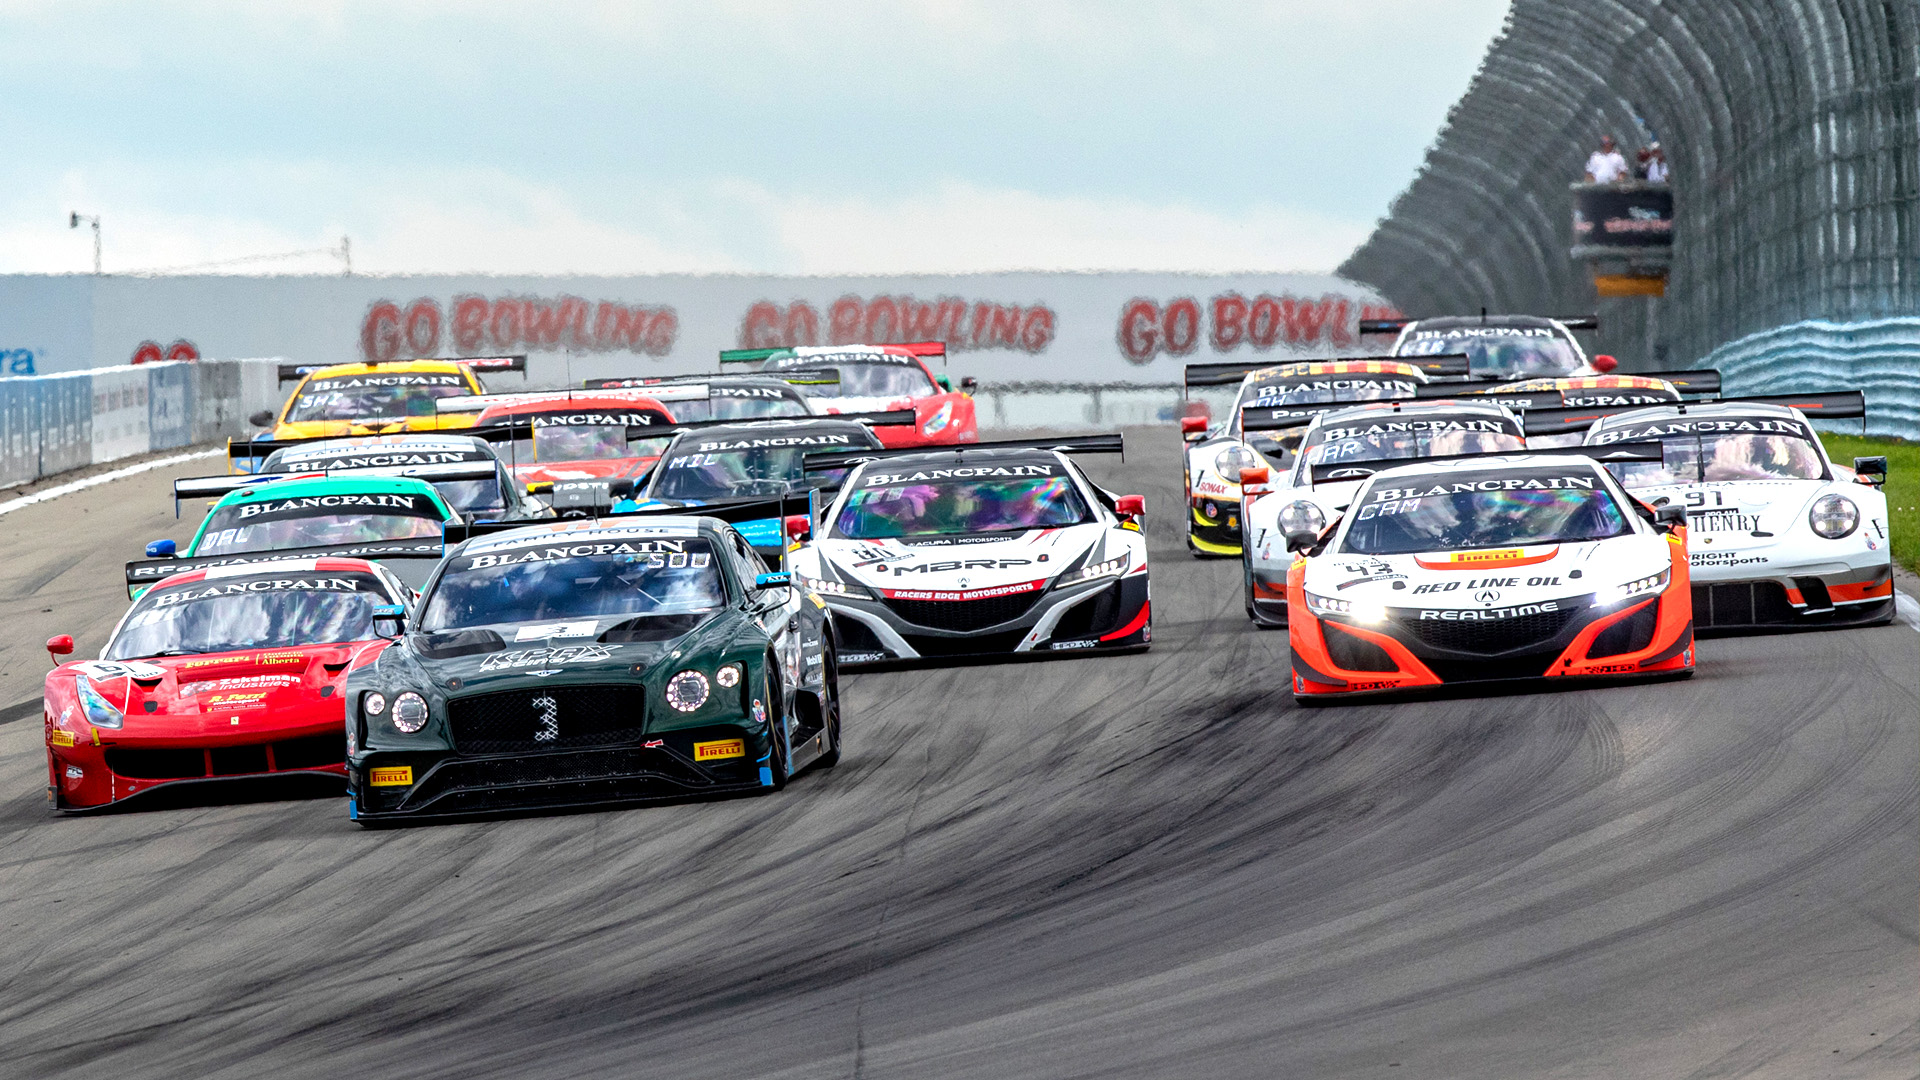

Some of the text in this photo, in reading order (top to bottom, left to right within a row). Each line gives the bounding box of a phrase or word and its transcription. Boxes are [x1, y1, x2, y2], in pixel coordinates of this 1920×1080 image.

[450, 293, 679, 355] BOWLING
[1117, 297, 1201, 364] GO
[1416, 329, 1552, 341] BLANCPAIN
[777, 352, 910, 368] BLANCPAIN
[313, 374, 460, 392] BLANCPAIN
[1257, 379, 1417, 398] BLANCPAIN
[1322, 420, 1504, 443] BLANCPAIN
[1594, 420, 1805, 446] BLANCPAIN
[699, 434, 850, 452] BLANCPAIN
[288, 452, 465, 473] BLANCPAIN
[864, 465, 1052, 488] BLANCPAIN
[1374, 476, 1596, 503] BLANCPAIN
[1685, 491, 1723, 507] 91
[238, 494, 415, 520] BLANCPAIN
[1356, 498, 1421, 521] CAM
[493, 527, 670, 548] FAMILY HOUSE
[958, 536, 1013, 544] MOTORSPORTS
[467, 539, 686, 571] BLANCPAIN
[1689, 556, 1769, 567] otorsports
[893, 558, 1033, 577] MBRP
[153, 578, 360, 608] BLANCPAIN
[894, 583, 1035, 600] RACERS EDGE MOTORSPORTS
[1412, 576, 1562, 595] RED LINE OIL
[1418, 601, 1560, 620] REALTIME
[262, 657, 300, 665] Alberta
[219, 674, 301, 686] Zekelman
[219, 680, 291, 691] Industries
[532, 696, 559, 742] 3
[699, 740, 741, 757] PIRELLI
[372, 770, 408, 783] PIRELLI
